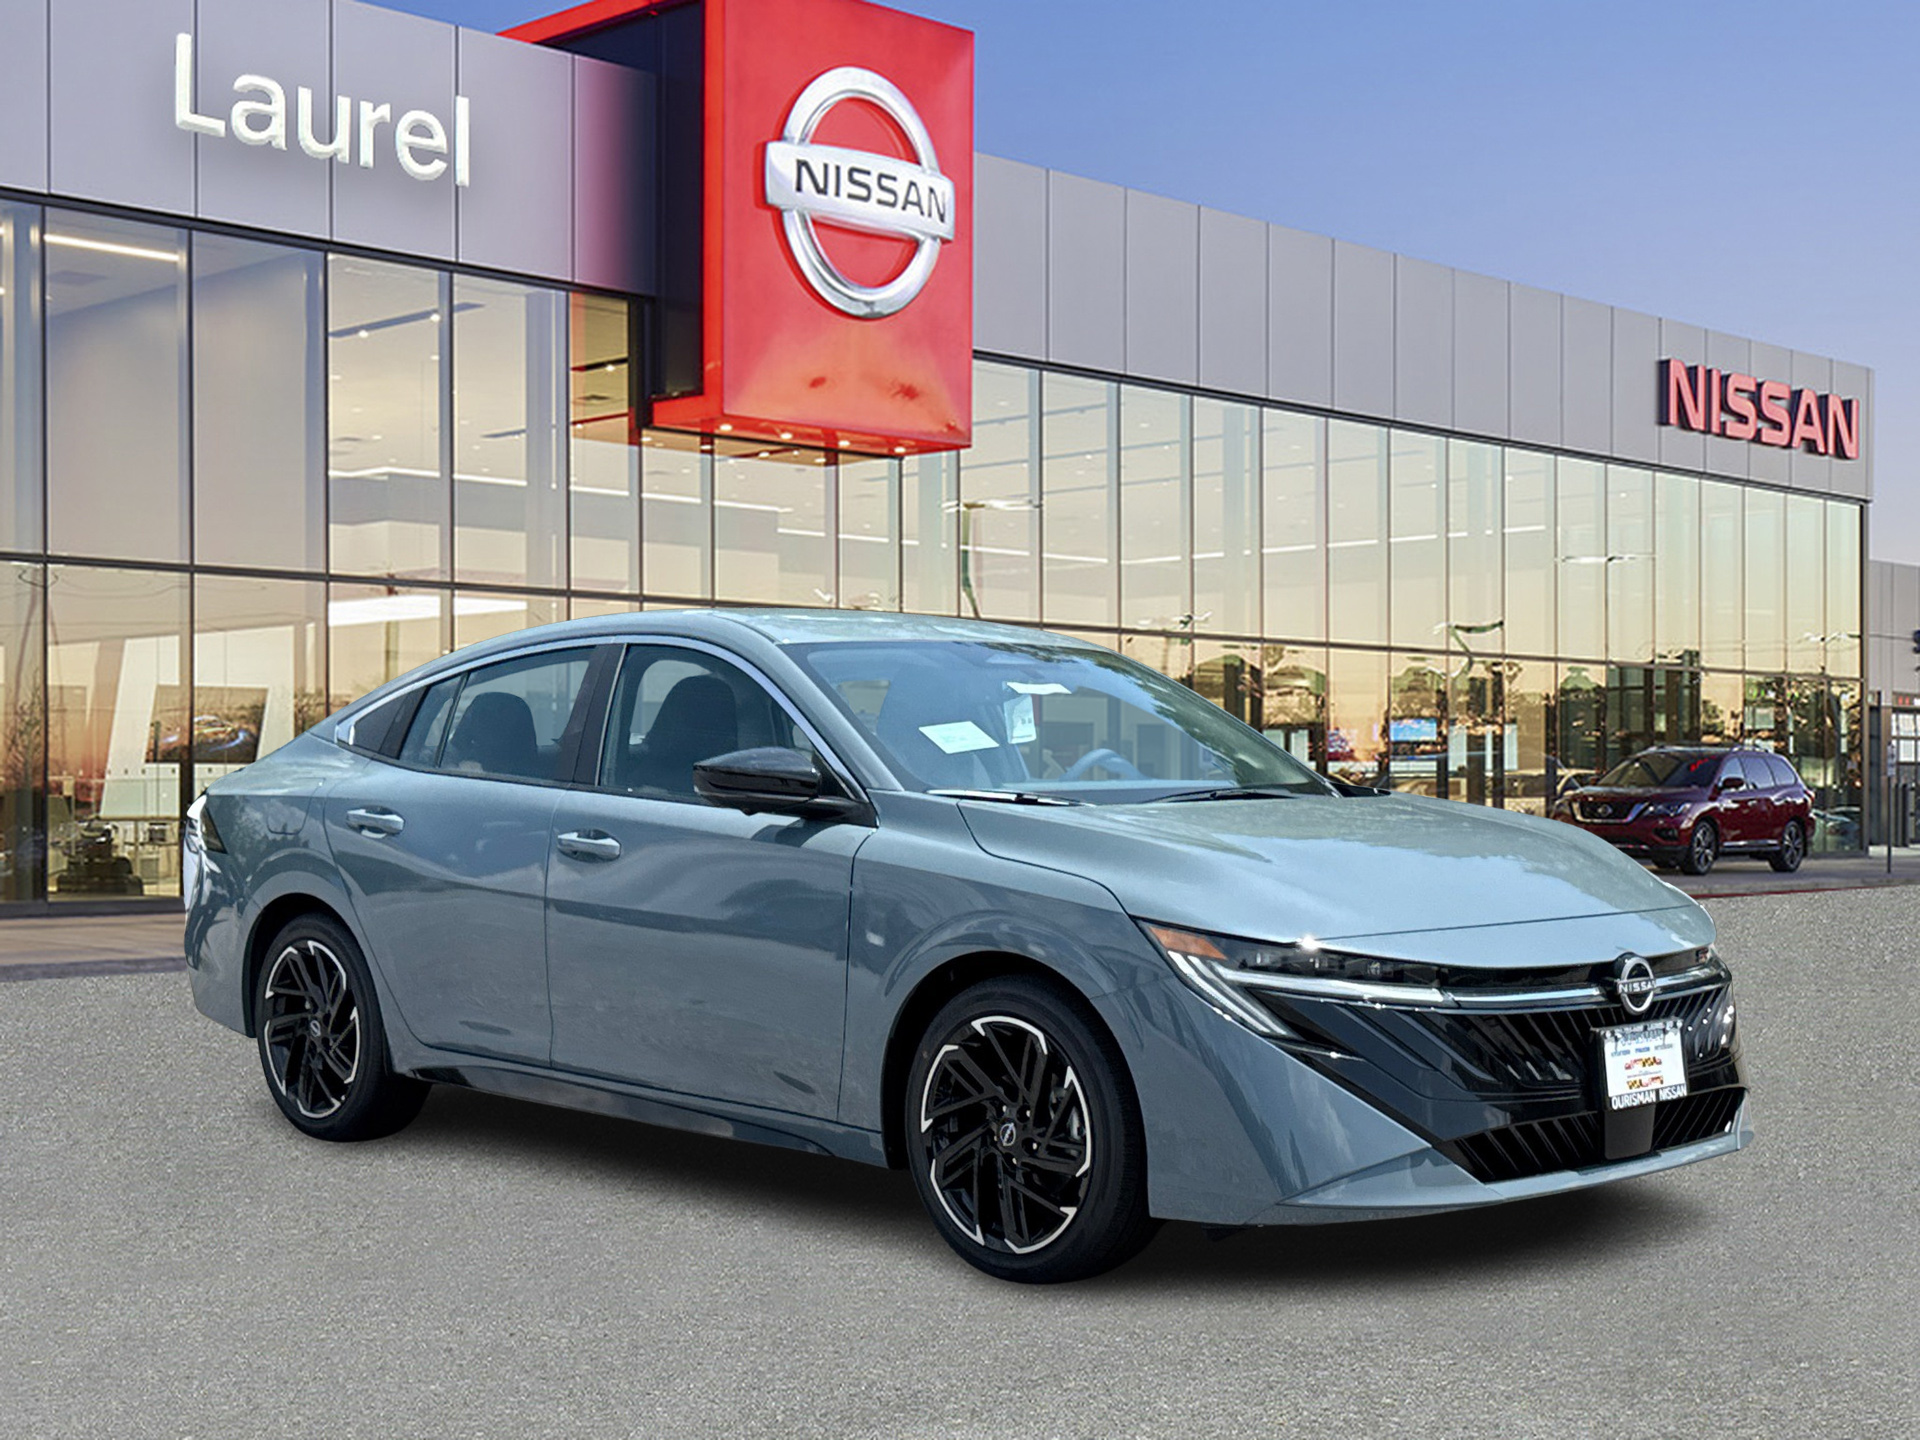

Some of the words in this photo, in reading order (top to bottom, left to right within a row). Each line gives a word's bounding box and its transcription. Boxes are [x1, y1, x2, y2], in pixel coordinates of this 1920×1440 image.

[175, 32, 470, 187] Laurel
[795, 158, 947, 224] NISSAN
[1657, 358, 1860, 460] NISSAN
[1611, 1090, 1656, 1110] OURISMAN
[1659, 1083, 1687, 1101] NISSAN
